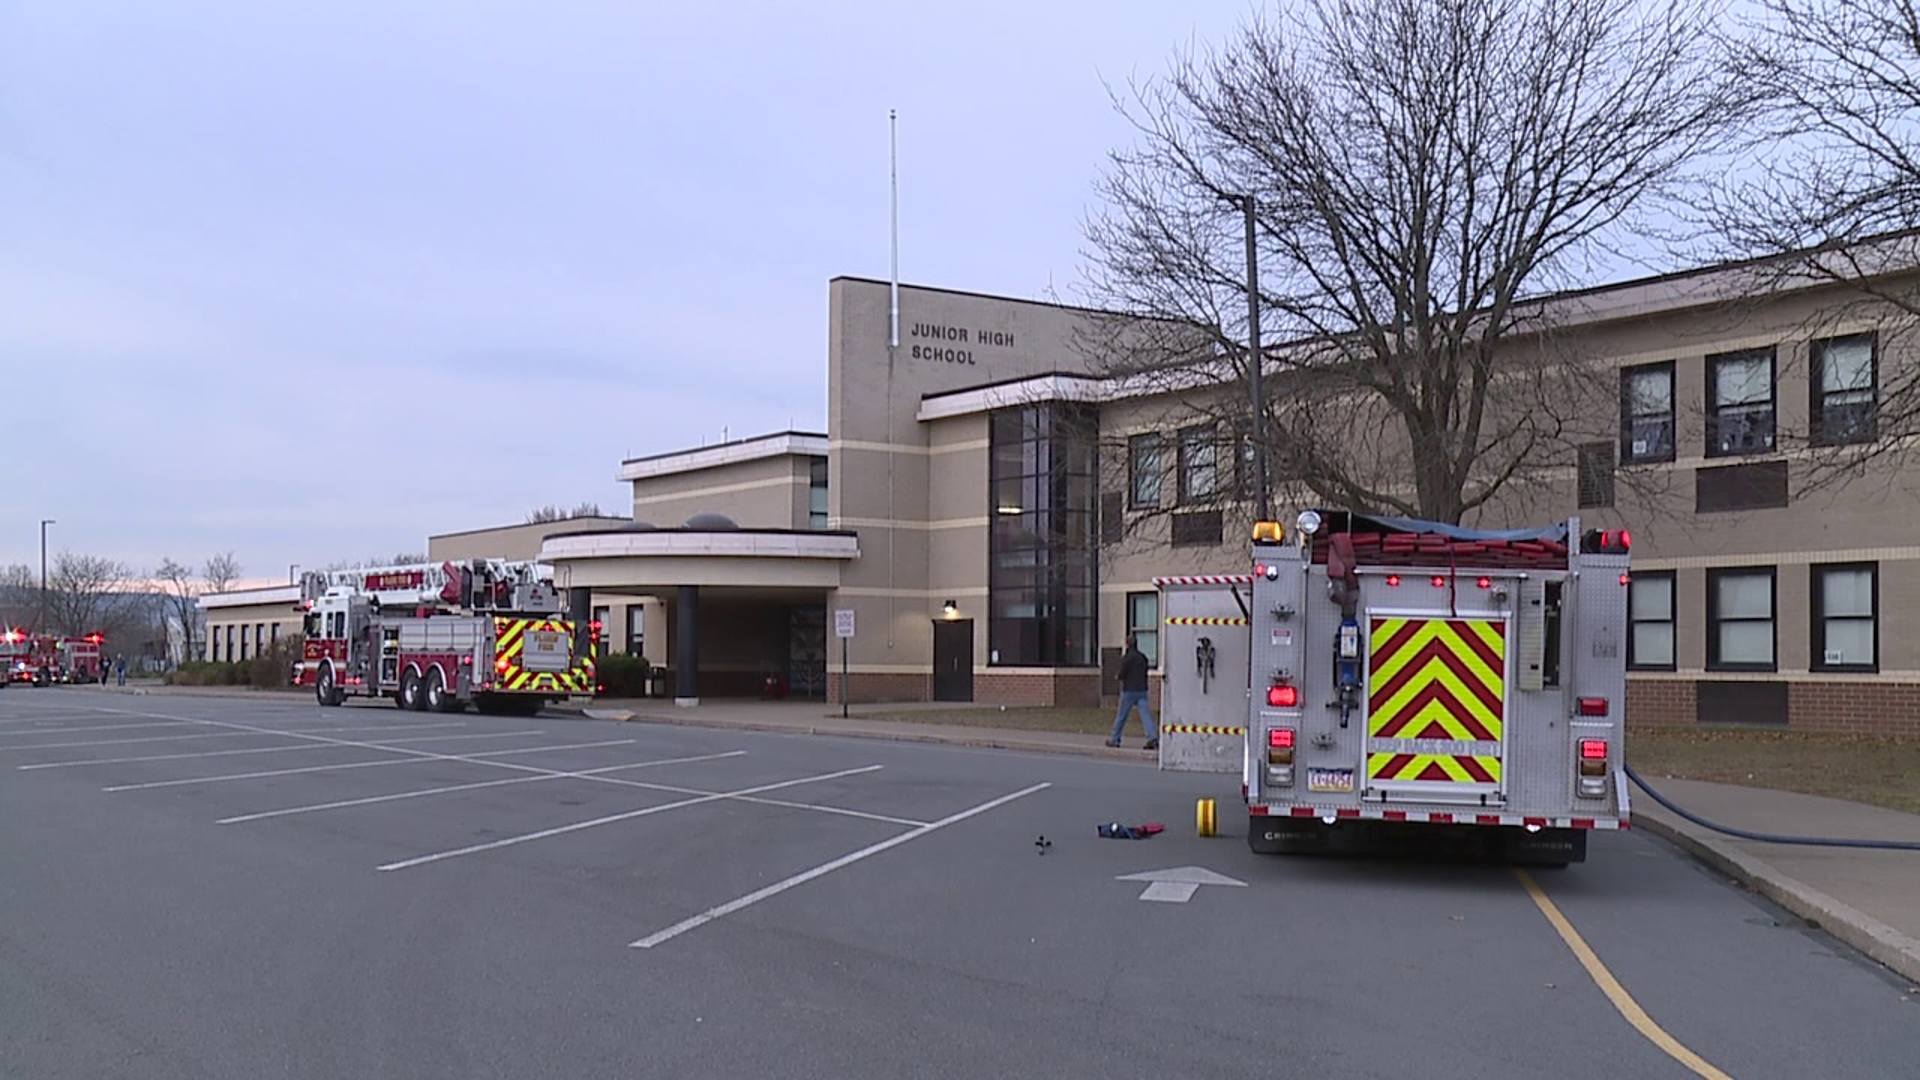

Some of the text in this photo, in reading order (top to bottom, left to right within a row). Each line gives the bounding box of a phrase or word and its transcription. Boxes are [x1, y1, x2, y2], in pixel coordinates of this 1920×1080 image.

[911, 323, 1014, 347] JUNIOR HIGH
[912, 345, 976, 365] SCHOOL
[1404, 738, 1438, 754] BACK
